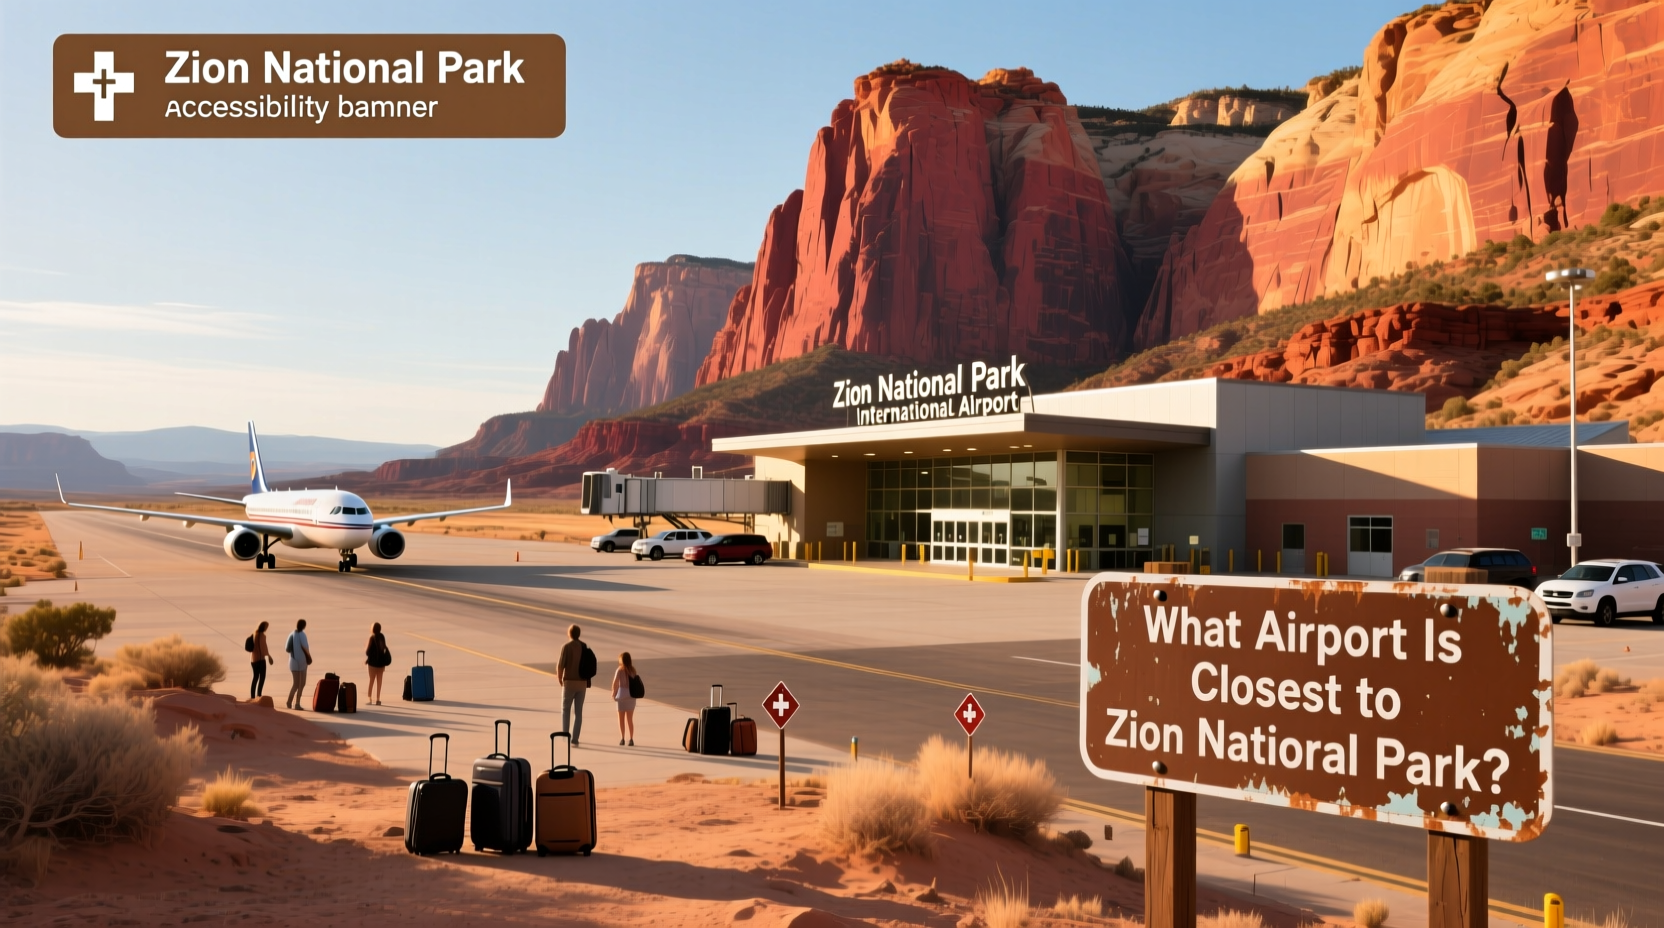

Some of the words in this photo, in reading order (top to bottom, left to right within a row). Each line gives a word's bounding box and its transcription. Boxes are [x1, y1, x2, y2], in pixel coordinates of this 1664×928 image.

[833, 379, 872, 408] Zion
[878, 363, 963, 403] National
[971, 355, 1026, 392] Park
[856, 397, 955, 426] International
[1143, 604, 1242, 649] What
[1255, 610, 1408, 666] Airport
[1425, 618, 1463, 664] Is
[1191, 661, 1342, 715] Closest
[1356, 677, 1402, 720] to
[1105, 708, 1183, 754] Zion
[1198, 717, 1359, 777] Natioral
[1376, 737, 1511, 796] Park?
